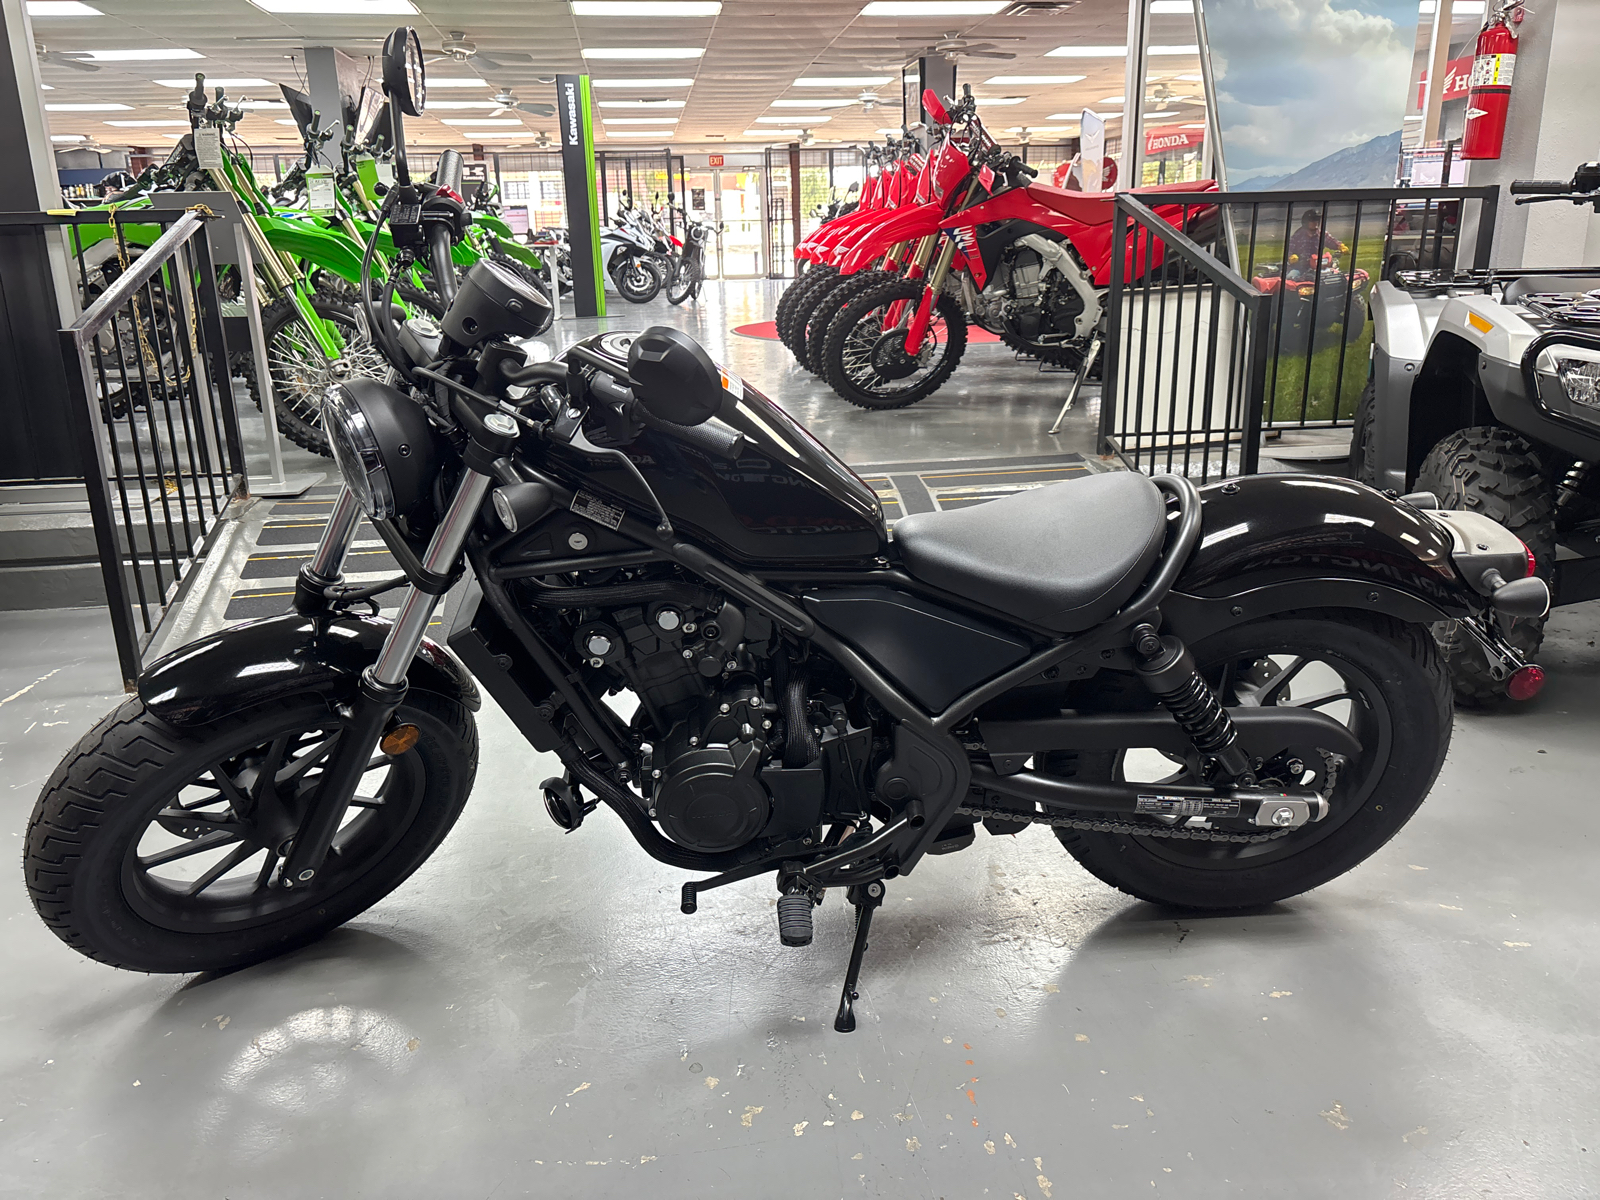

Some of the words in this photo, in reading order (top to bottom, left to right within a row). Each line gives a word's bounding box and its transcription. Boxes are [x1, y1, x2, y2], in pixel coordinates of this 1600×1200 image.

[564, 82, 579, 146] Kawasaki
[1152, 133, 1190, 150] HONDA
[710, 156, 723, 165] EXIT
